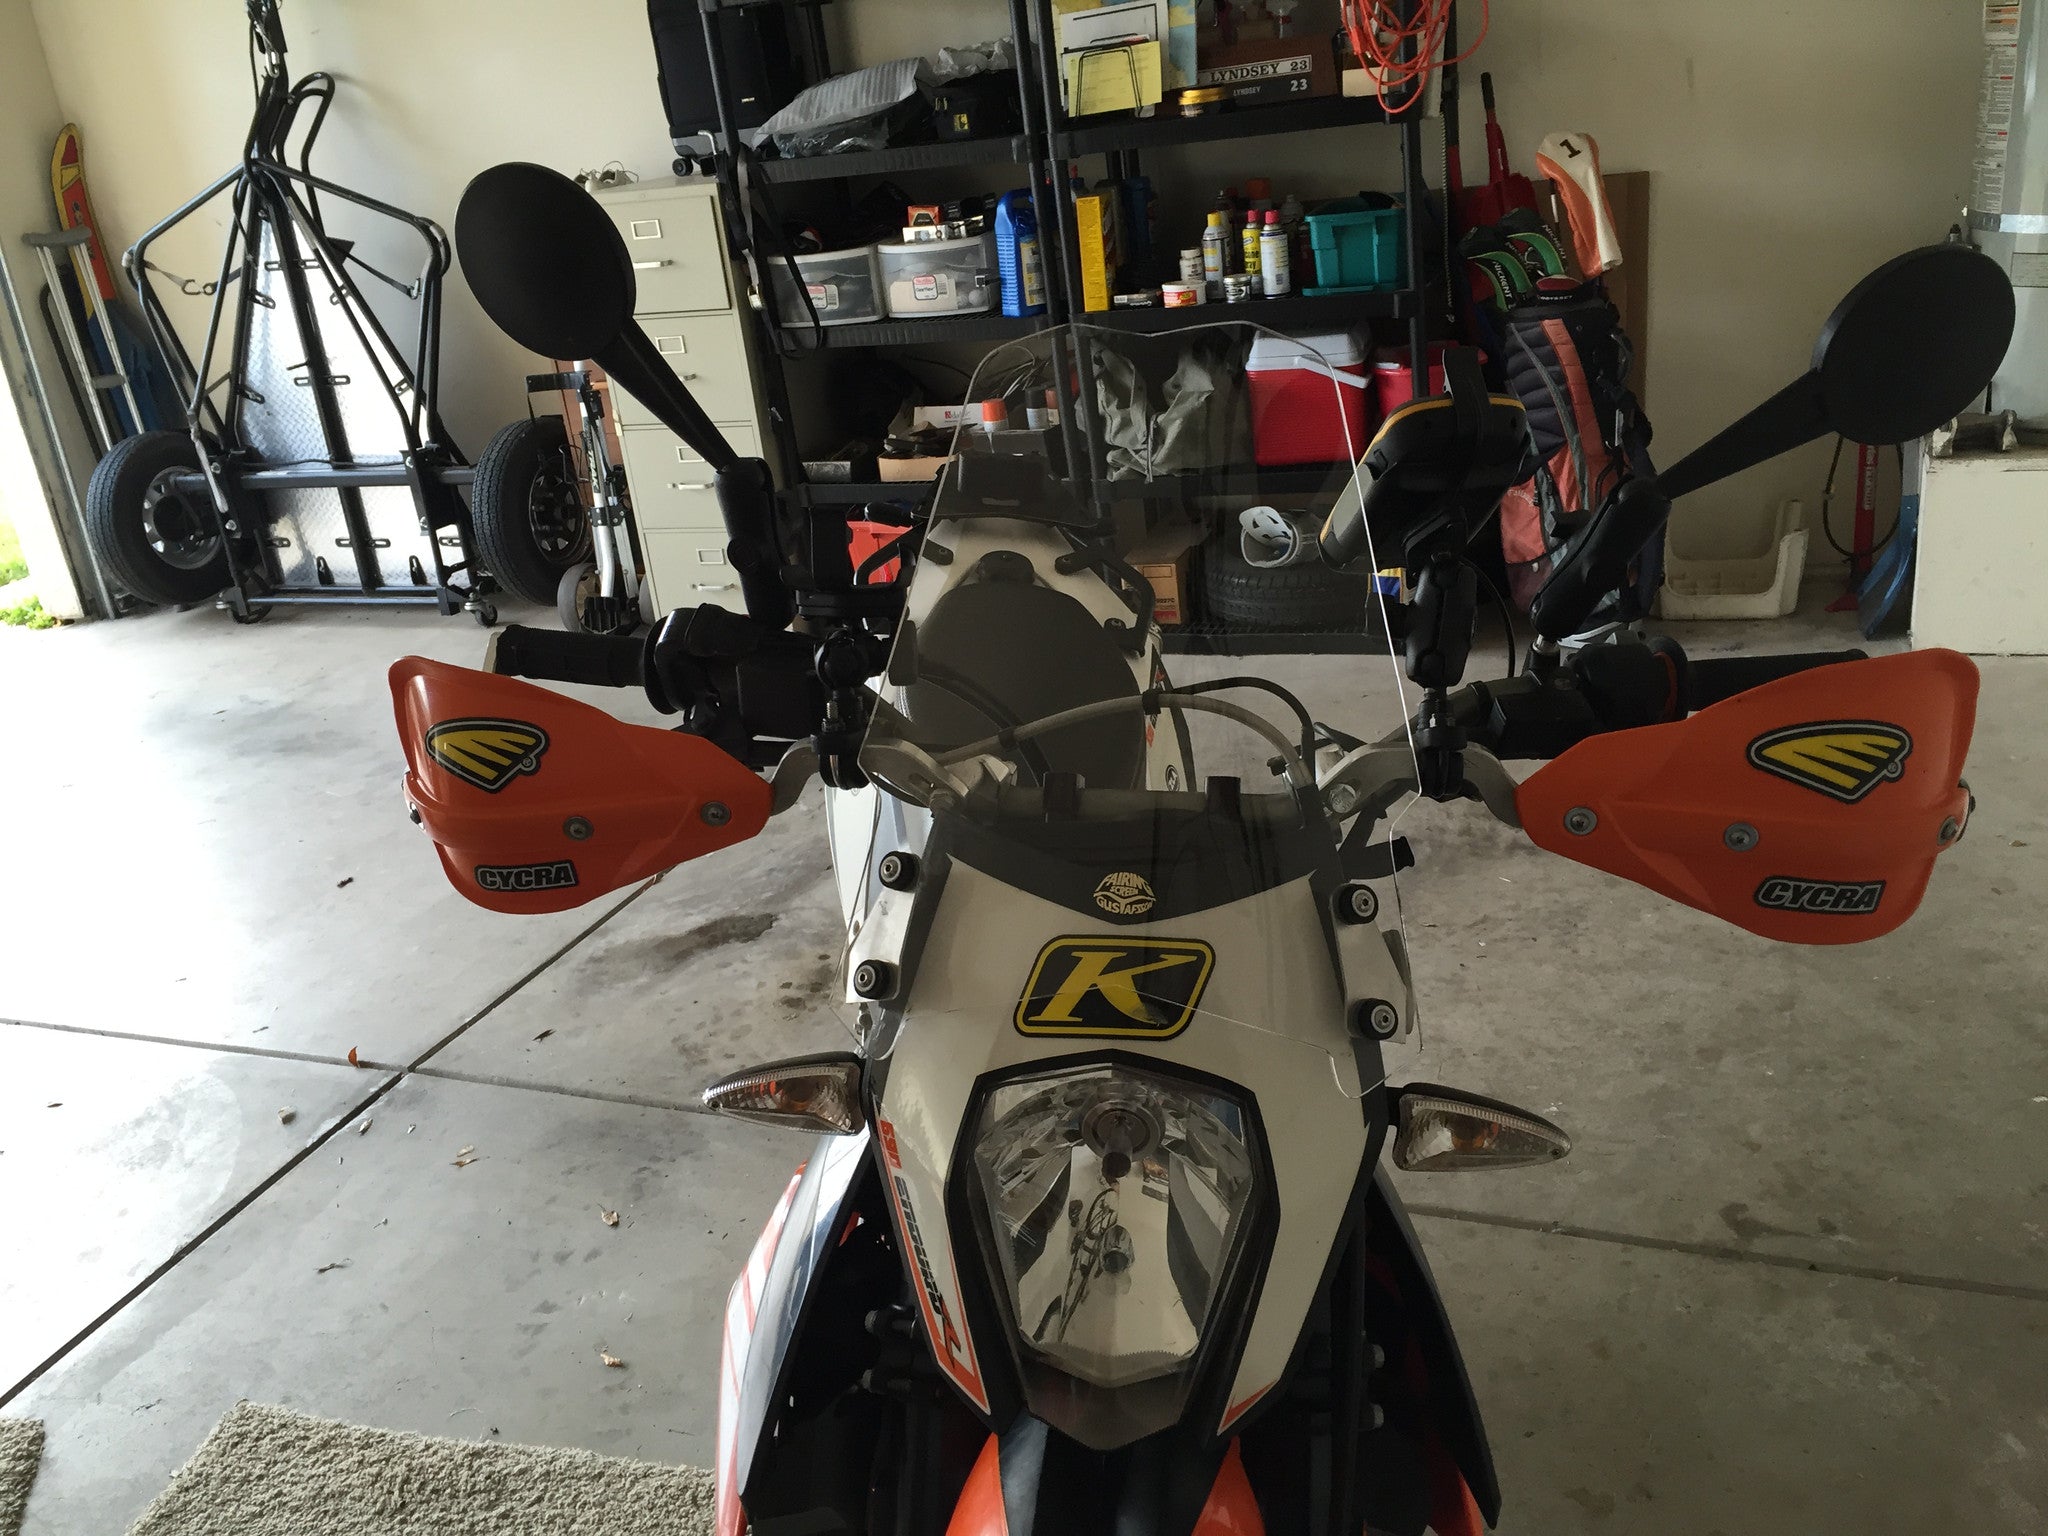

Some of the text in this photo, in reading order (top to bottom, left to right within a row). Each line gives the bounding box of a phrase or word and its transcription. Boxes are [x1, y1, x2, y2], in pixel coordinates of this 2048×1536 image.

[1210, 60, 1308, 82] LYNDSEY 23
[1233, 78, 1308, 97] LYNDSEY 23
[1560, 139, 1581, 158] 1
[1493, 260, 1513, 299] NICKENT
[478, 864, 575, 889] CYCRA
[1094, 872, 1155, 897] FAIRING
[1109, 885, 1139, 897] SCREEN
[1758, 880, 1882, 911] CYCRA
[1027, 951, 1198, 1026] K
